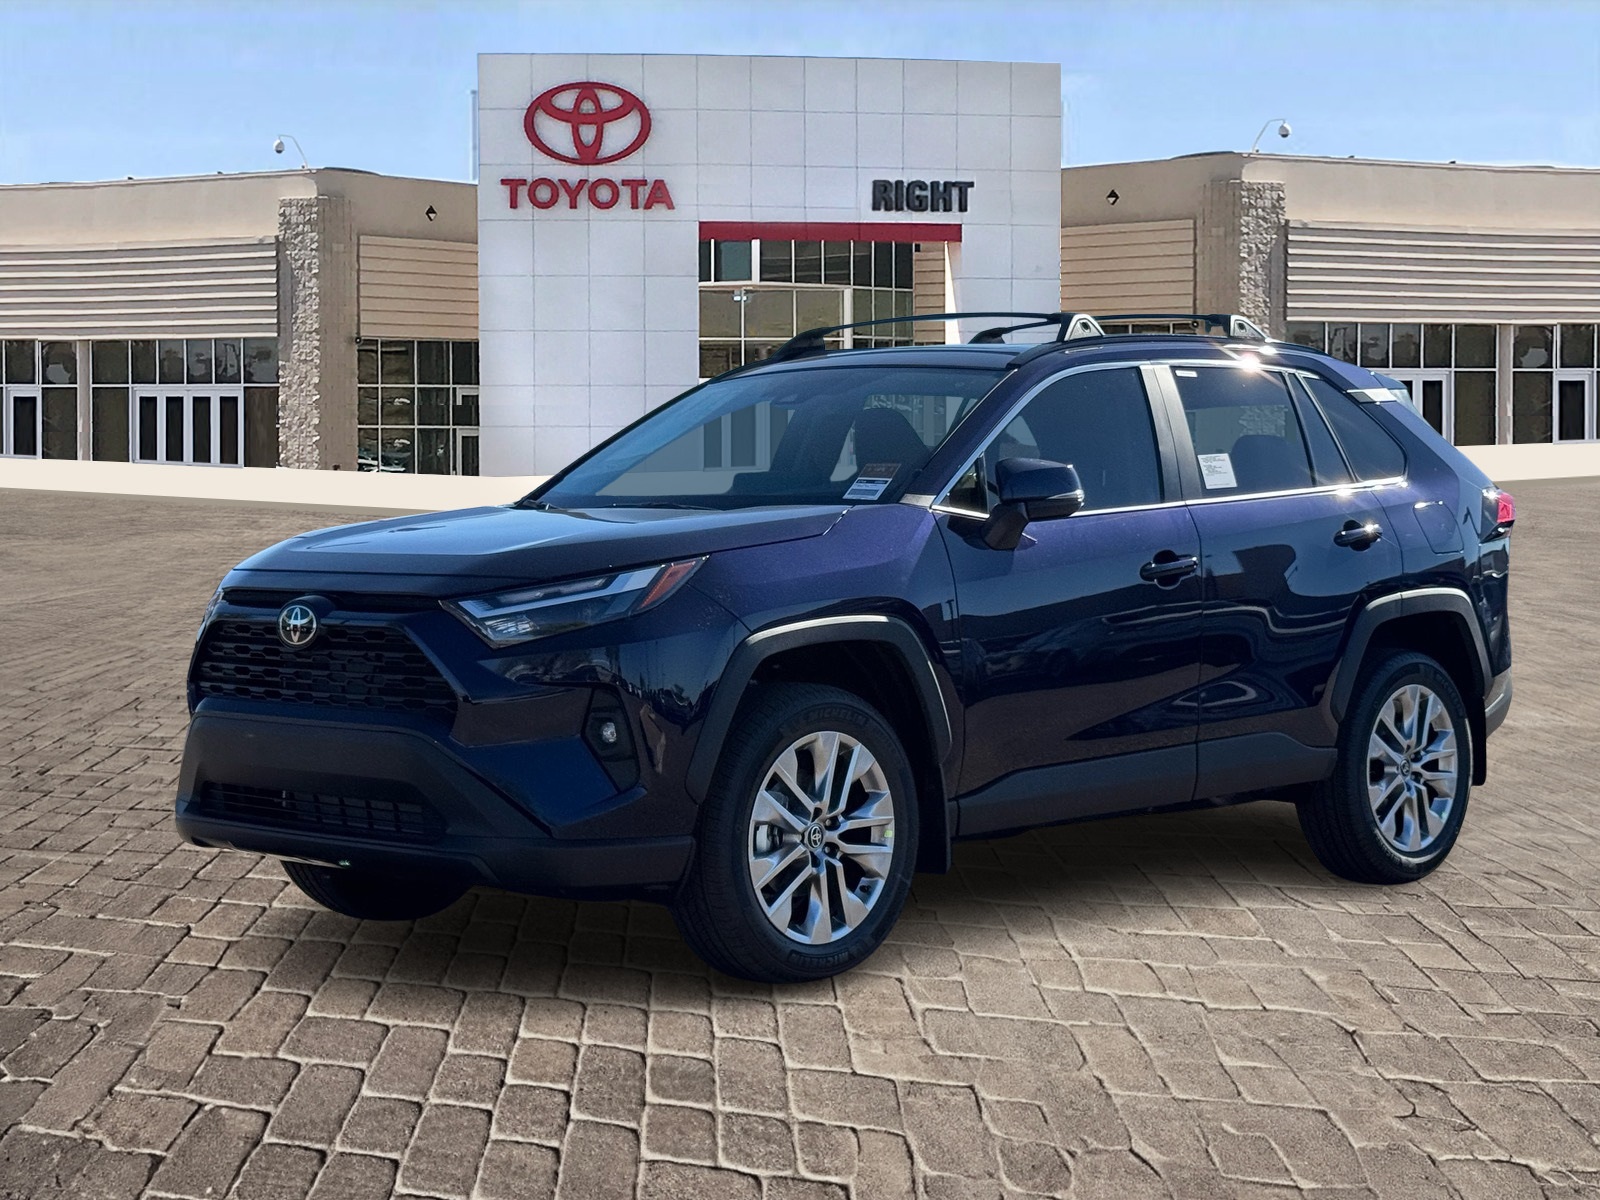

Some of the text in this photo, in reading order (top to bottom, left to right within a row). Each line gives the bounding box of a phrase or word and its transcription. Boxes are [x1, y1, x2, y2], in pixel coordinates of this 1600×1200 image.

[501, 178, 674, 210] TOYOTA
[871, 179, 975, 212] RIGHT
[809, 707, 867, 726] MICHELIN
[790, 951, 849, 969] MICHELIN
